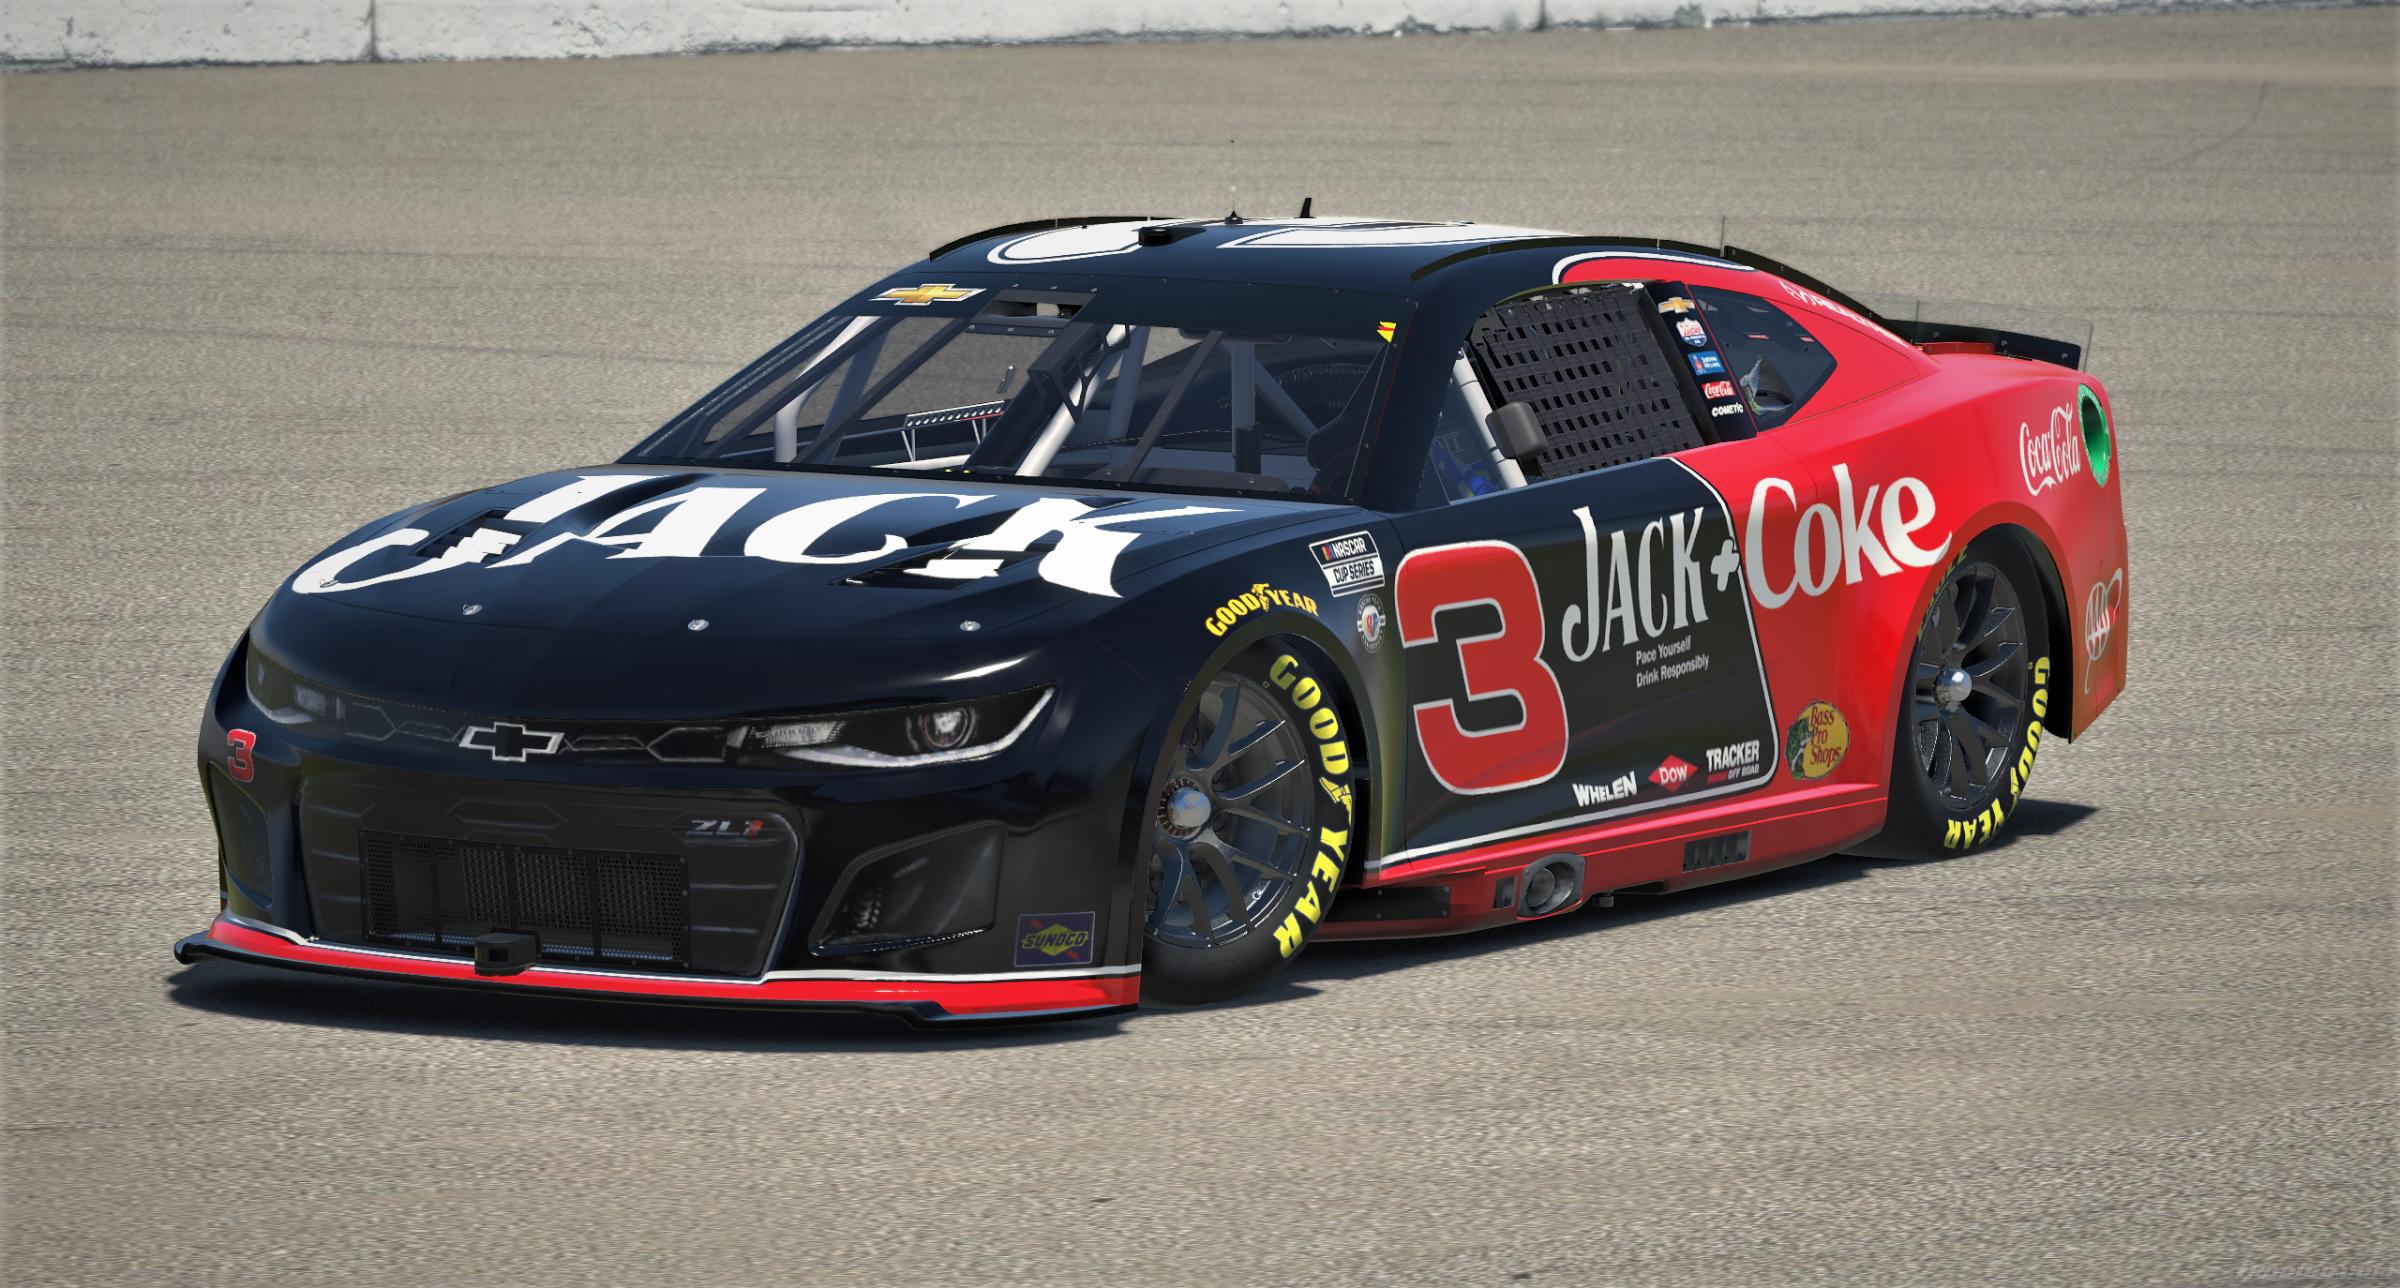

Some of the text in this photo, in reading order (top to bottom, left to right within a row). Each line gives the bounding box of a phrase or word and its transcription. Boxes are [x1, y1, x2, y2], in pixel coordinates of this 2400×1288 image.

[291, 474, 1246, 598] JACK
[1332, 537, 1367, 559] NASCAR
[1333, 560, 1375, 583] CUP SERIES
[1561, 505, 1709, 663] JACK
[1745, 462, 1952, 610] Coke
[1636, 634, 1691, 666] Pace Yourself
[1394, 539, 1569, 797] 3
[1636, 653, 1710, 689] Drink Responsibly
[1810, 706, 1835, 728] Bass
[227, 728, 257, 783] 3
[1706, 739, 1760, 772] TRACKER
[1728, 763, 1760, 780] OFF ROAD
[1572, 770, 1638, 807] WHELEN
[1022, 931, 1088, 949] SUNOCO
